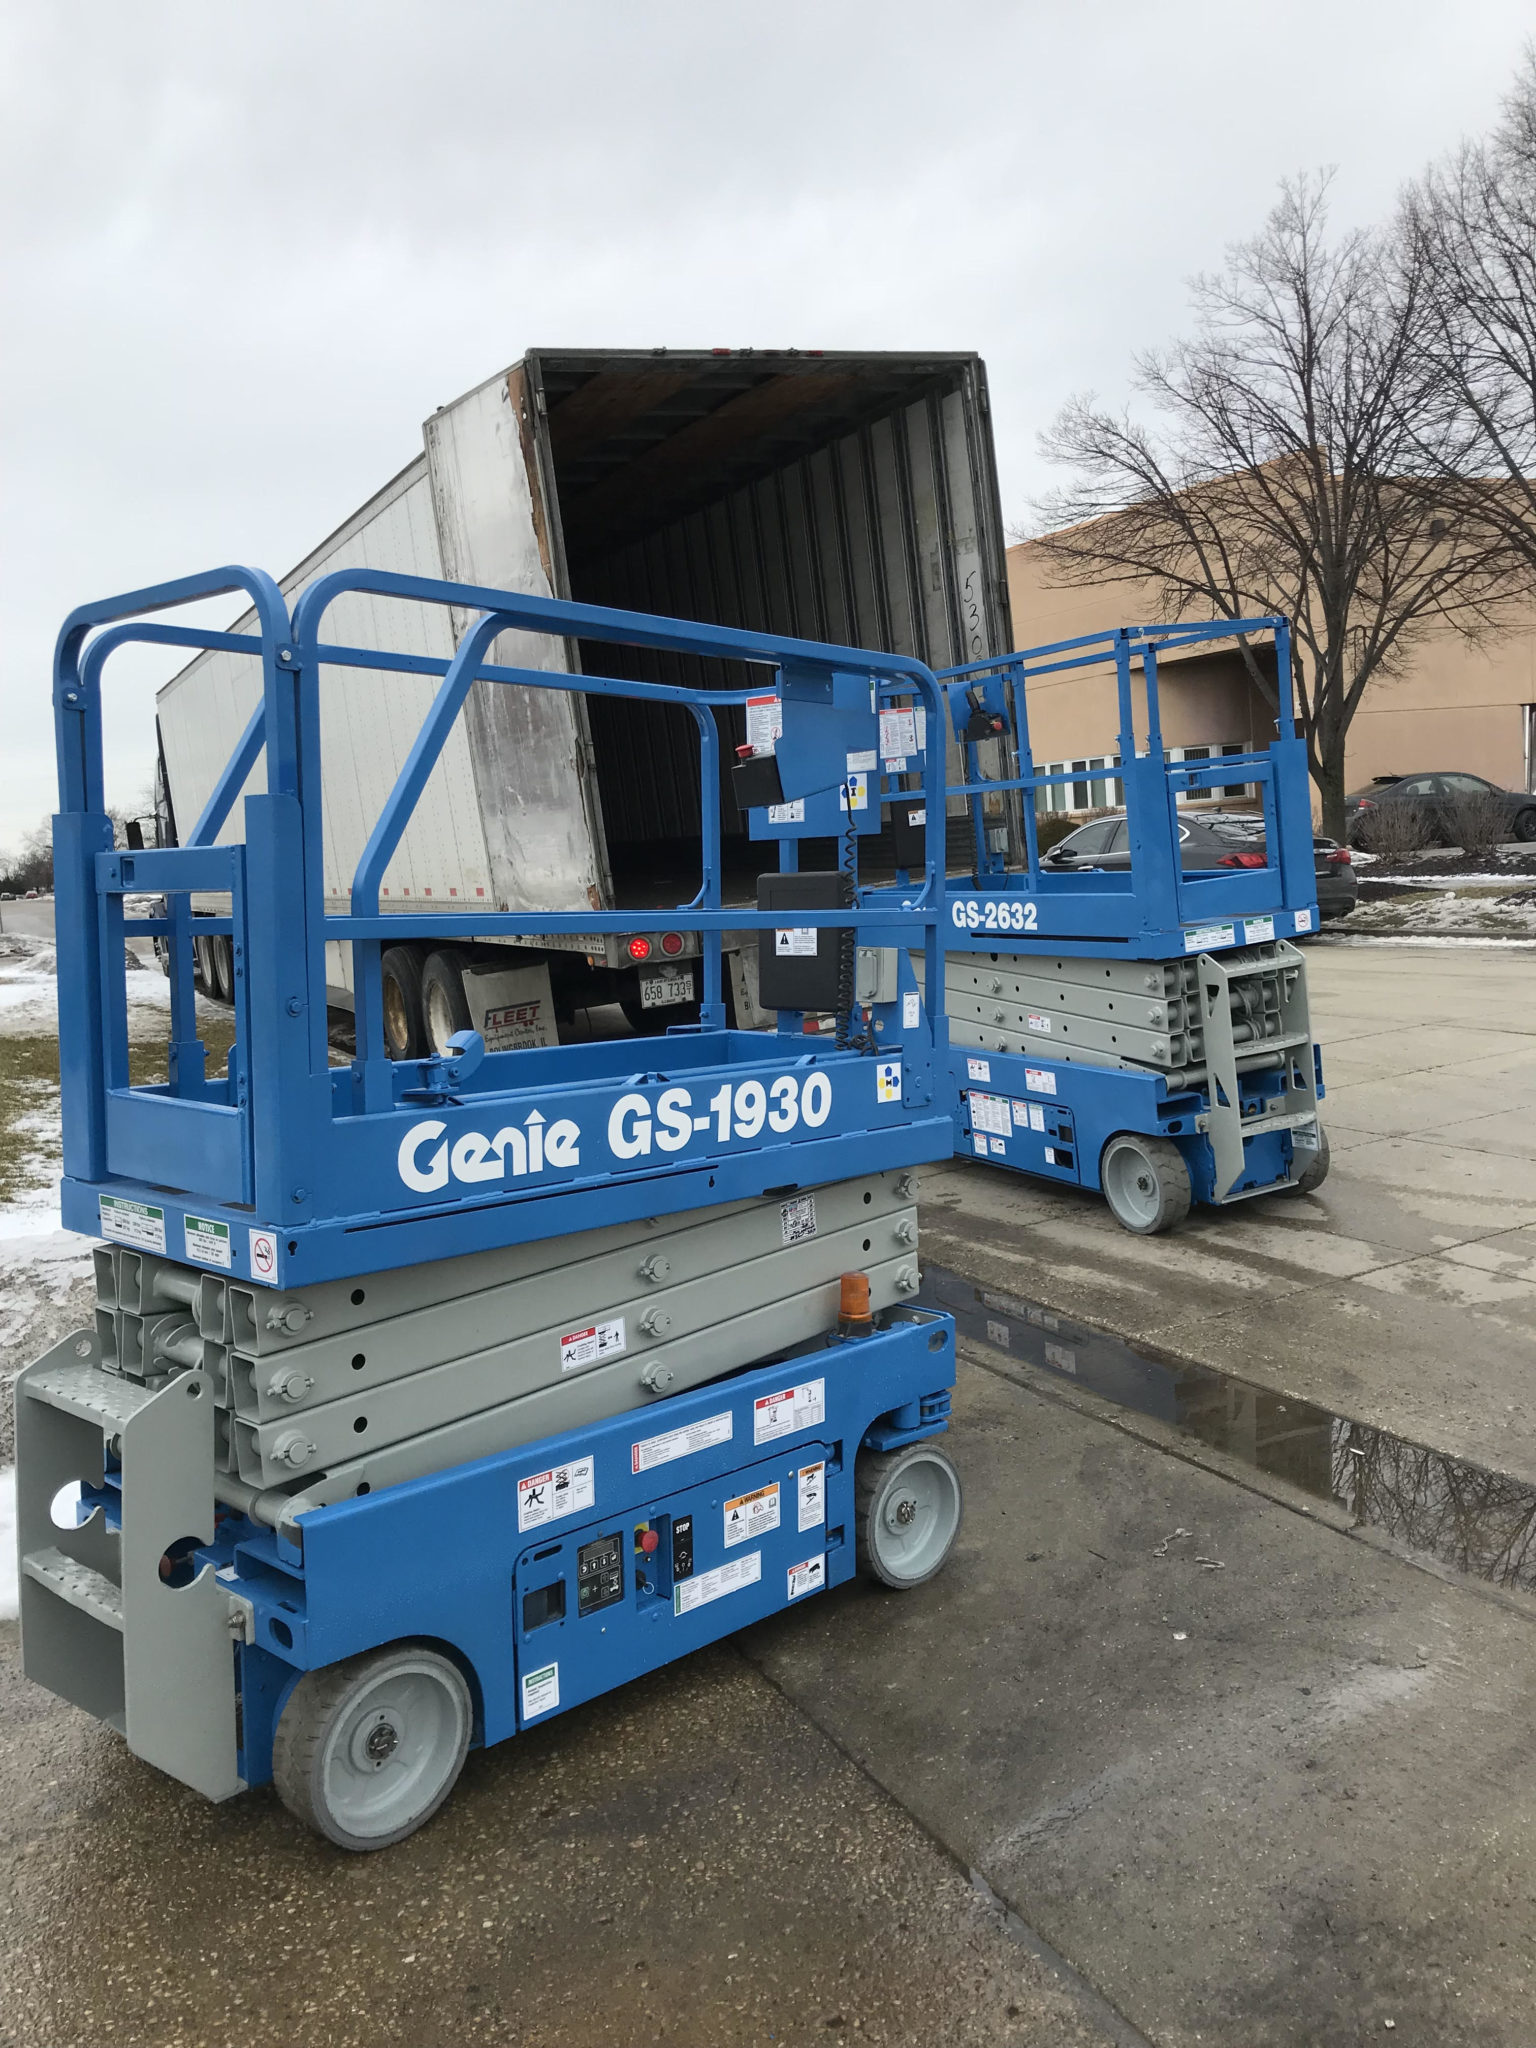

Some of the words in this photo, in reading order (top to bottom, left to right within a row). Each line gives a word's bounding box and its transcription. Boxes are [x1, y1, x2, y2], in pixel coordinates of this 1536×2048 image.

[951, 900, 1038, 932] GS-2632
[644, 985, 663, 1001] 658
[668, 981, 686, 998] 733
[484, 1000, 541, 1028] FLEET
[397, 1108, 582, 1194] Genie
[607, 1071, 833, 1160] GS-1930
[113, 1199, 149, 1216] INSTRUCTIONS
[197, 1221, 215, 1234] NOTICE
[527, 1473, 551, 1489] DANGER
[744, 1489, 765, 1503] WARNING
[675, 1521, 690, 1535] STOP
